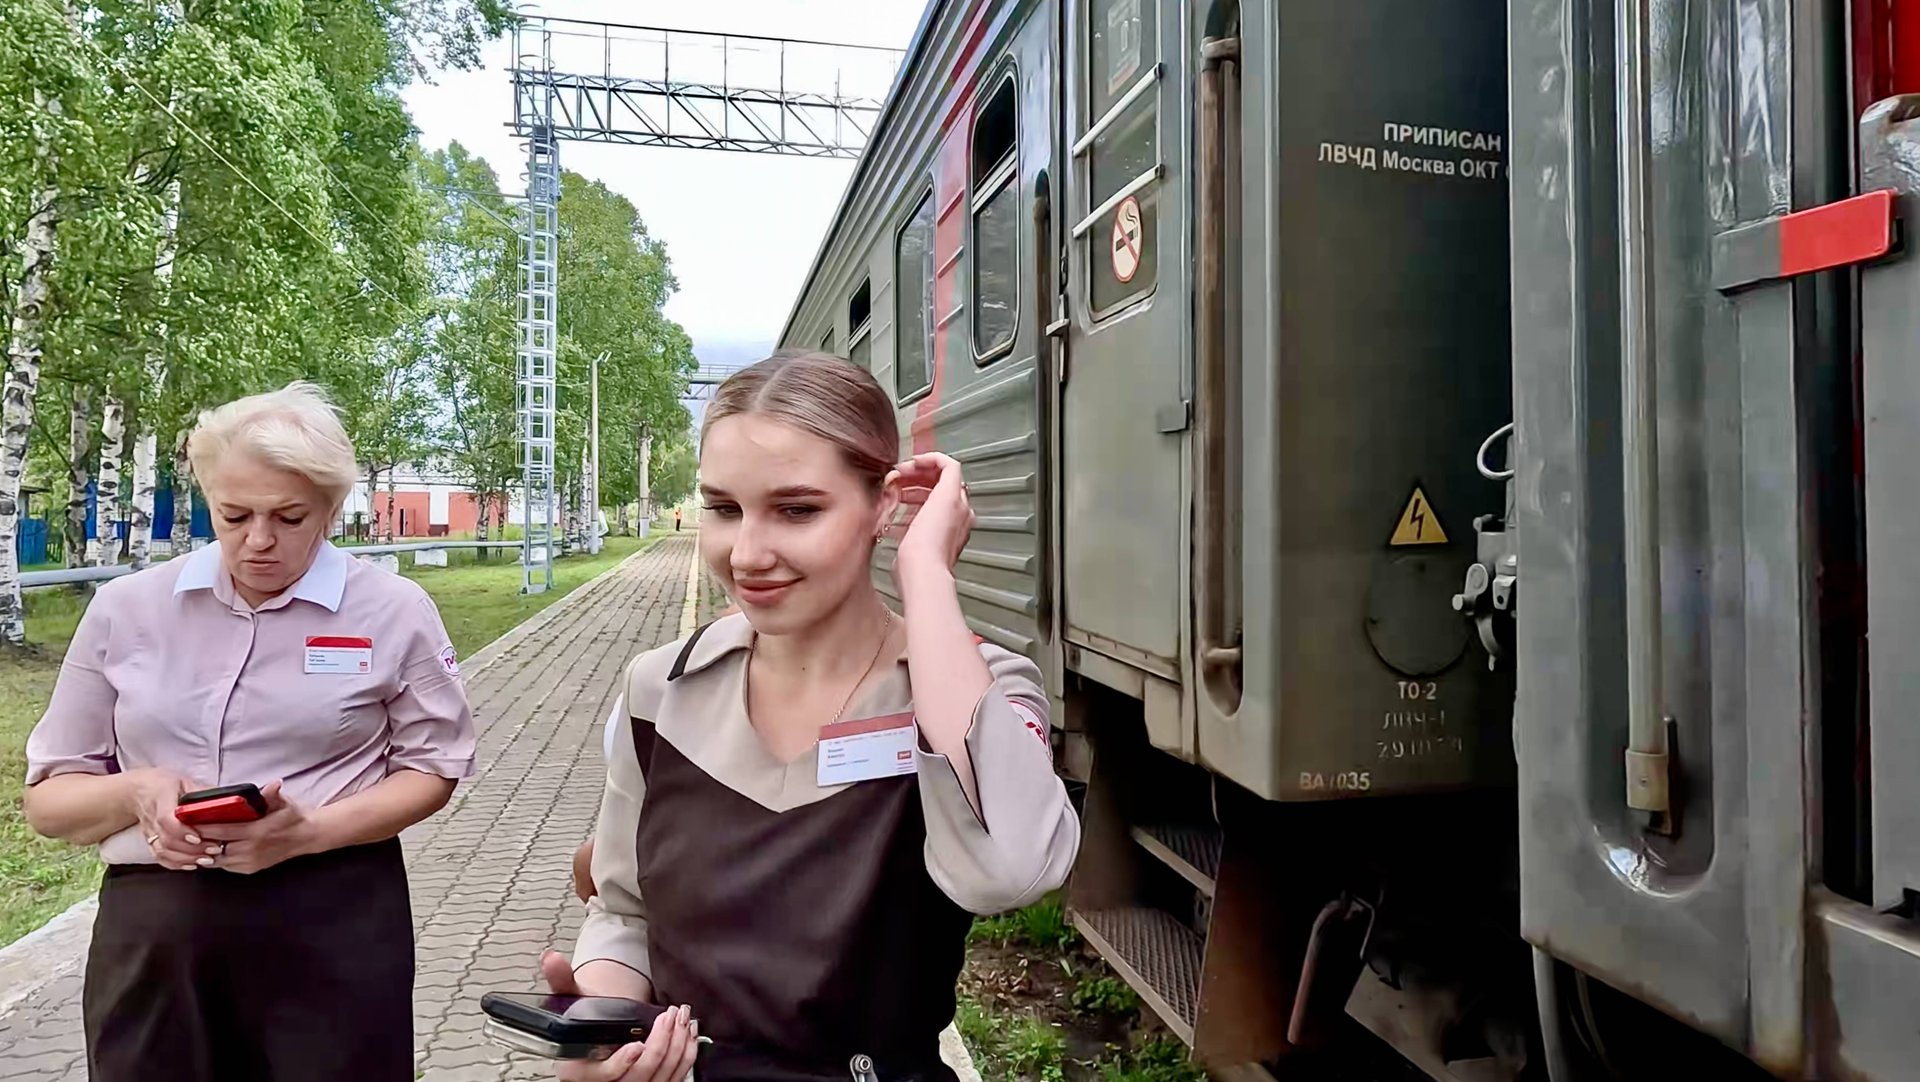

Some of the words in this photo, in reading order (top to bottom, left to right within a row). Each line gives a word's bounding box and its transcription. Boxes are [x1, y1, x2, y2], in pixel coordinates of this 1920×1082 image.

[1383, 122, 1502, 152] ПРИПИСАН
[1318, 142, 1376, 170] ЛВЧД
[1382, 149, 1455, 176] Москва
[1460, 158, 1501, 180] ОКТ
